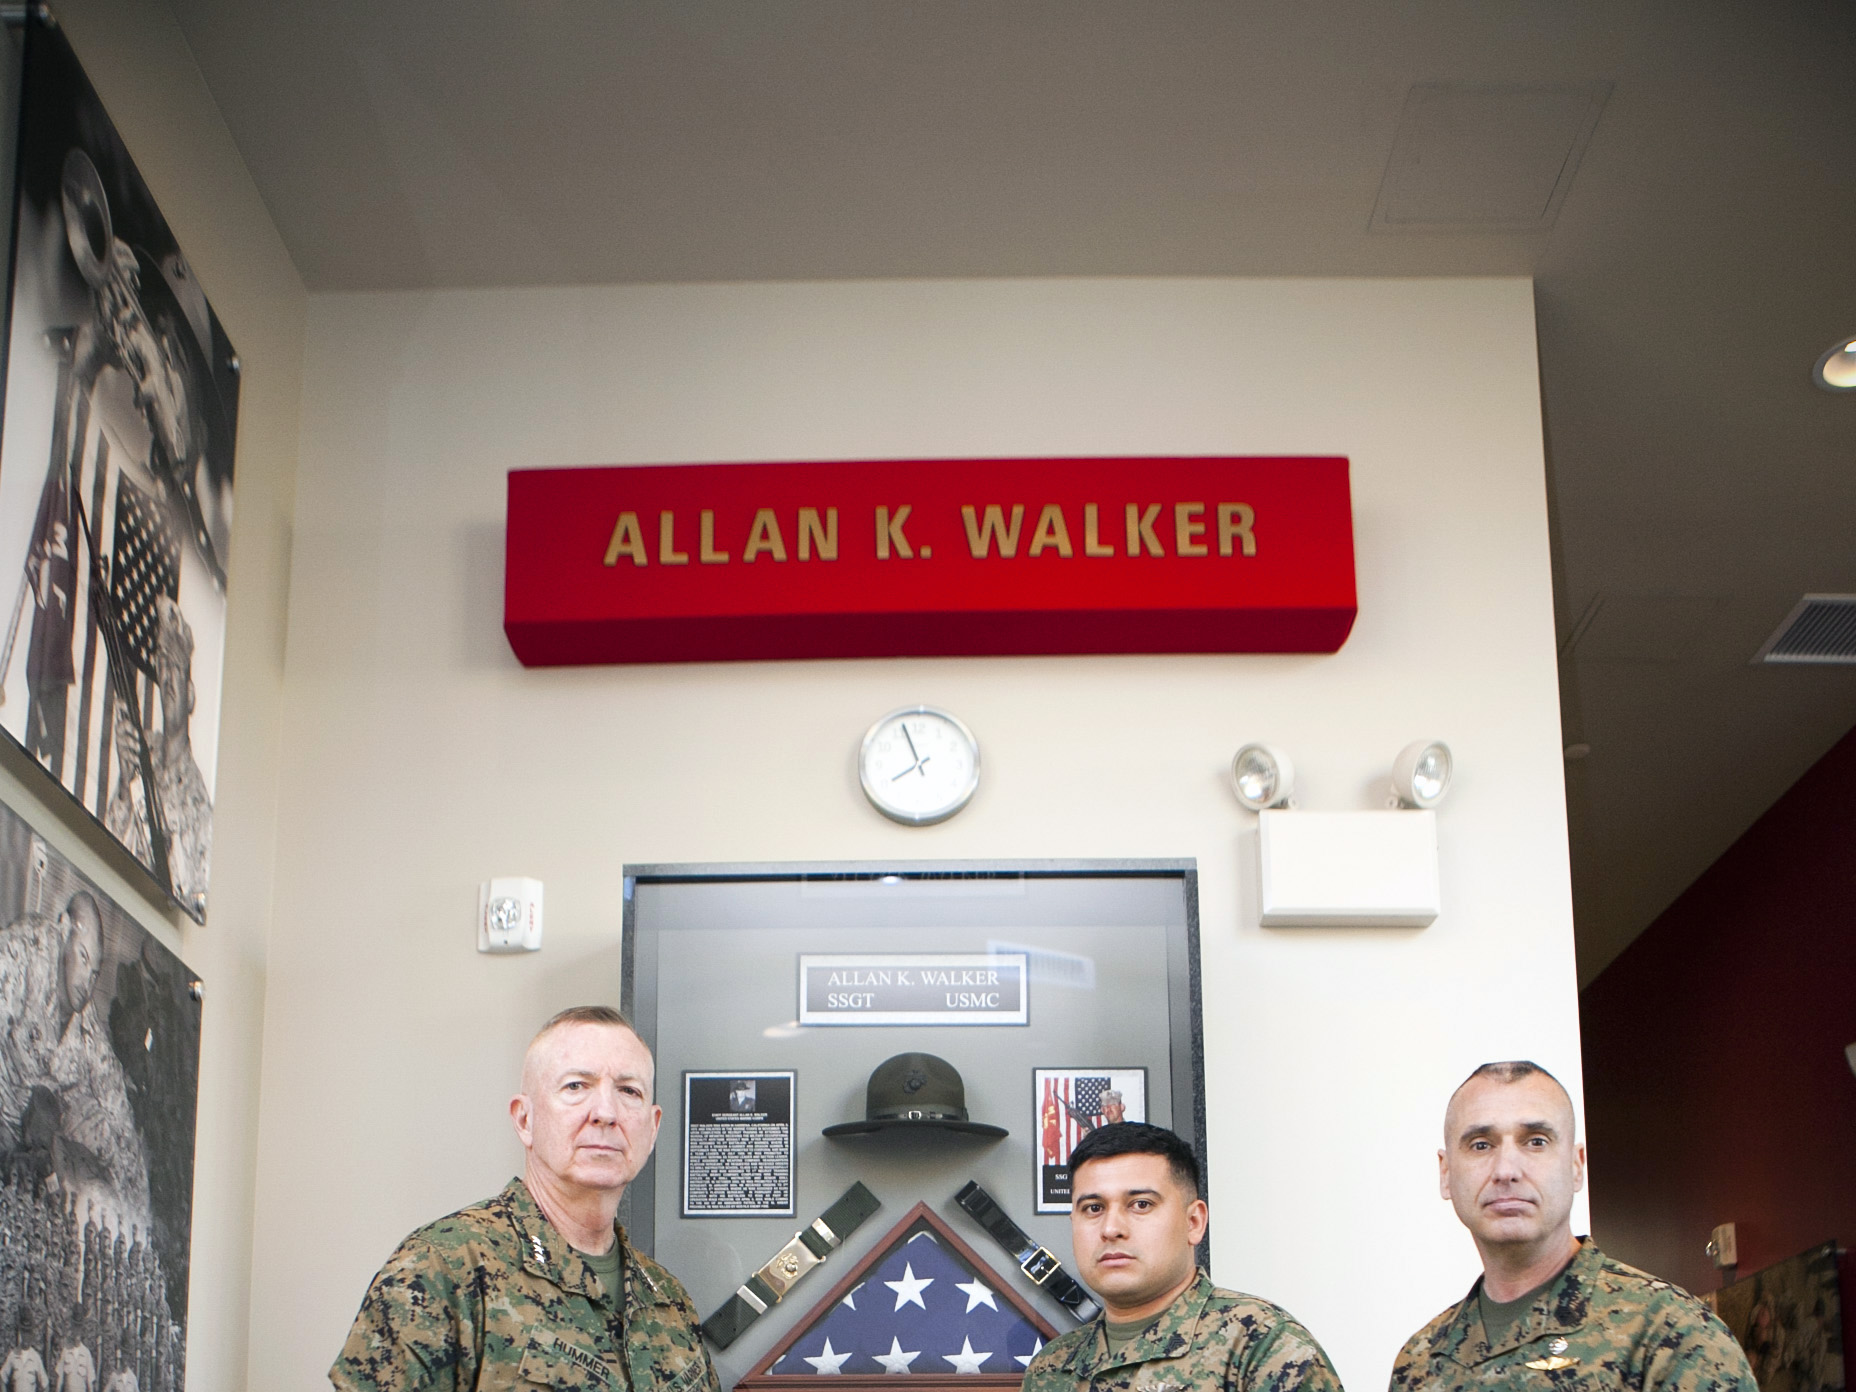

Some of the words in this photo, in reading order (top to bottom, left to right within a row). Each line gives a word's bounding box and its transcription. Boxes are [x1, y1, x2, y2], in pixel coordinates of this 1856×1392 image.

[603, 507, 839, 567] ALLAN
[875, 504, 931, 560] K.
[961, 502, 1257, 559] WALKER
[912, 722, 926, 734] 12
[828, 970, 891, 986] ALLAN
[897, 971, 915, 986] K.
[920, 970, 999, 986] WALKER
[827, 993, 875, 1008] SSGT
[946, 993, 1000, 1008] USMC
[553, 1337, 610, 1380] HUMMER
